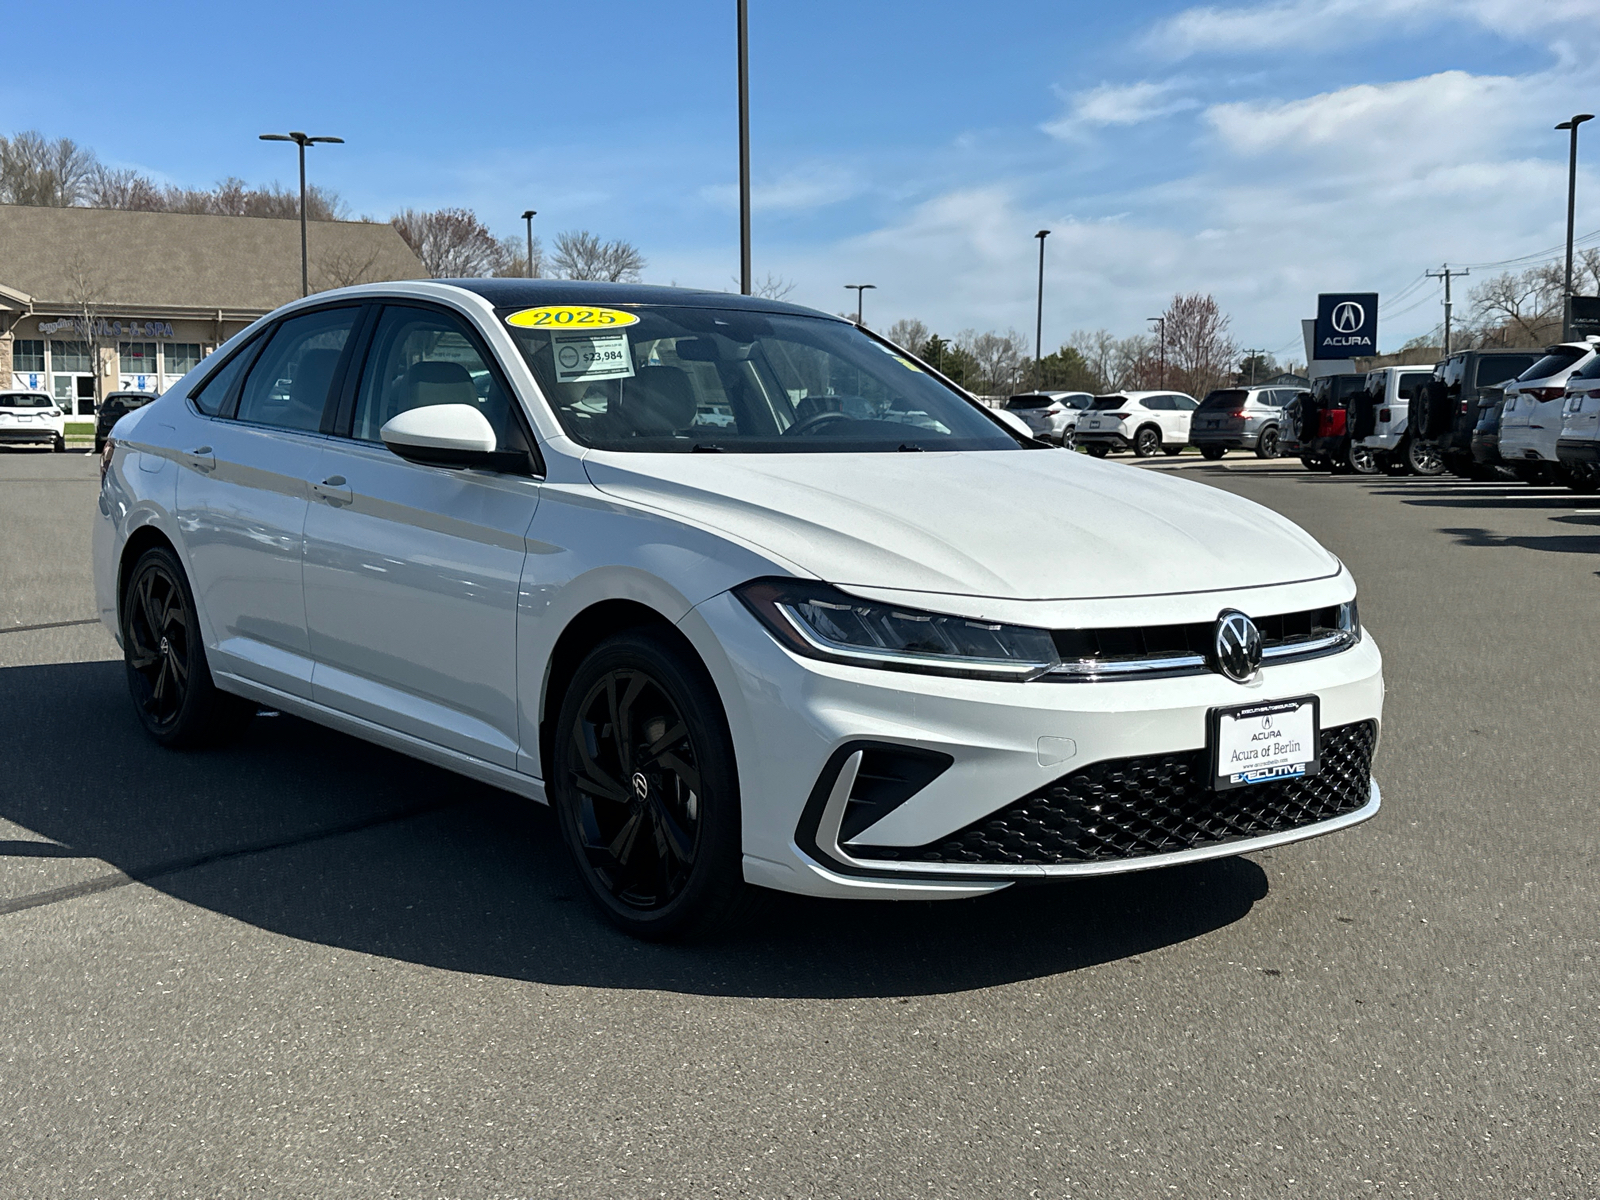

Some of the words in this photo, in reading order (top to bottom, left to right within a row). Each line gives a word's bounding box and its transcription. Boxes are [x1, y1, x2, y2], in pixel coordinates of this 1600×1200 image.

[533, 311, 616, 325] 2025
[129, 321, 139, 336] &
[144, 322, 174, 337] SPA
[1322, 336, 1371, 346] ACURA
[583, 350, 623, 363] $23,984
[1251, 730, 1282, 742] ACURA
[1230, 749, 1259, 763] Acura
[1261, 745, 1271, 758] of
[1273, 740, 1301, 756] Berlin
[1230, 763, 1305, 784] EXECUTIVE
